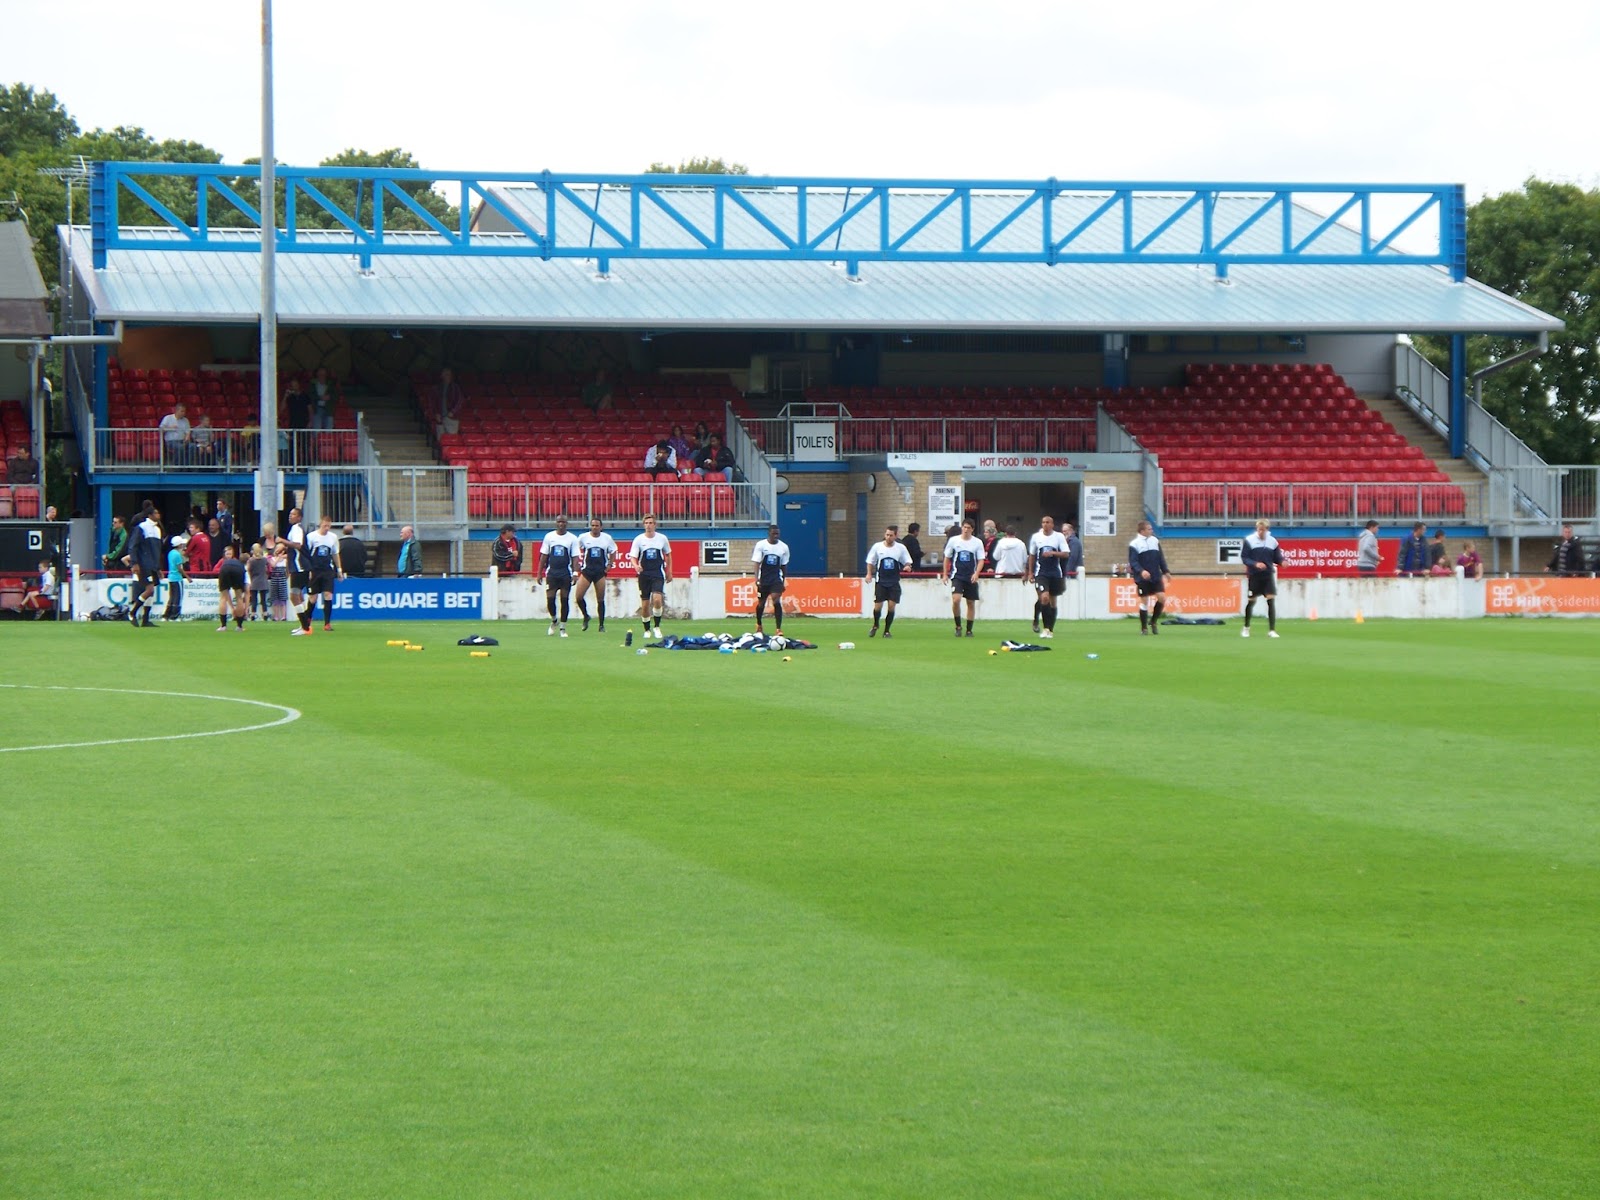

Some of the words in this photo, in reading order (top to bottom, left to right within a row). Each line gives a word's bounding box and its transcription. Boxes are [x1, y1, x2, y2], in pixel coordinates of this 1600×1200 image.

[796, 435, 834, 449] TOILETS
[980, 457, 995, 467] HOT
[998, 457, 1019, 467] FOOD
[1022, 457, 1038, 467] AND
[1040, 457, 1069, 467] DRINKS
[30, 534, 40, 546] D
[704, 548, 727, 564] E
[1219, 546, 1241, 562] F
[1298, 548, 1307, 557] is
[1309, 548, 1331, 557] their
[1333, 548, 1360, 557] colou
[1316, 557, 1325, 566] is
[1327, 558, 1344, 566] our
[358, 592, 438, 609] SQUARE
[444, 592, 481, 609] BET
[784, 595, 857, 608] Residential
[1166, 595, 1236, 608] Residential
